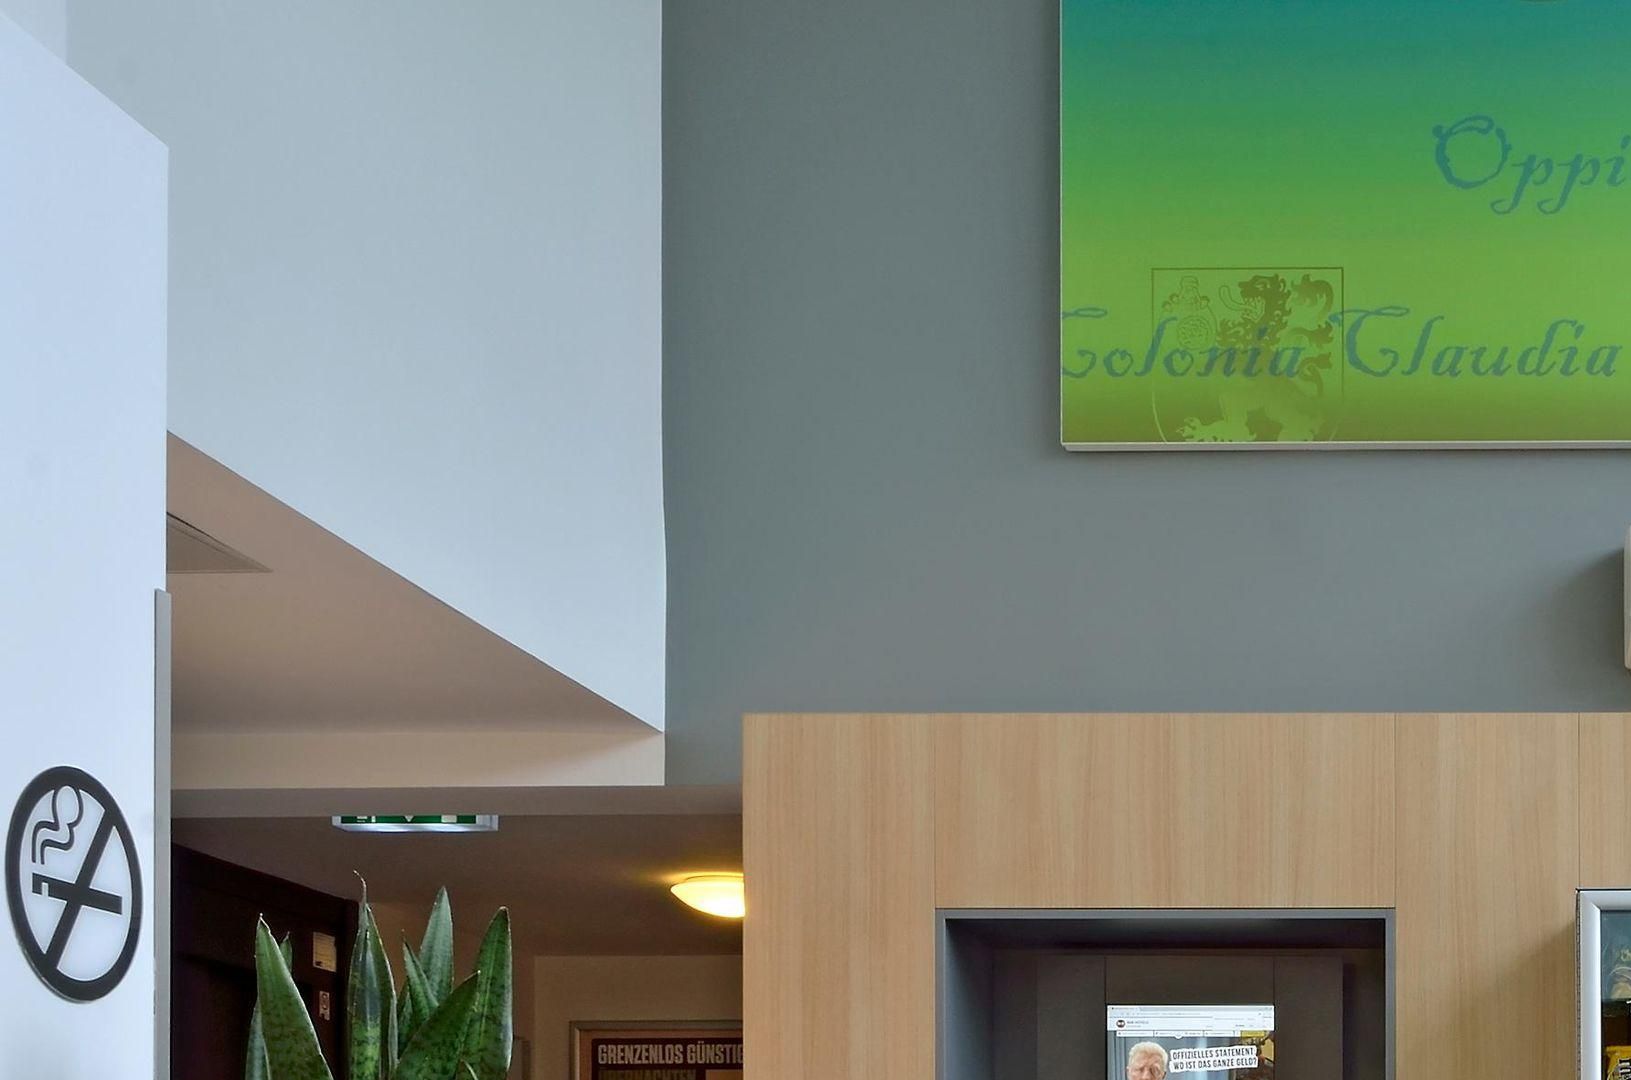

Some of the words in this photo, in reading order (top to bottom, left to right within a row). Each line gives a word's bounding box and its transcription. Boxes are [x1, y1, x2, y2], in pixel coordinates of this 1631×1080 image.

[1328, 305, 1623, 378] Claudia
[598, 1044, 684, 1065] GRENZENLOS
[1172, 1049, 1213, 1060] OFFIZIELLES
[1215, 1047, 1254, 1058] STATEMENT
[1173, 1061, 1184, 1070] WO
[1185, 1061, 1196, 1070] IST
[1197, 1060, 1212, 1069] DAS
[1213, 1058, 1235, 1068] GANZE
[1236, 1057, 1257, 1067] GELD?
